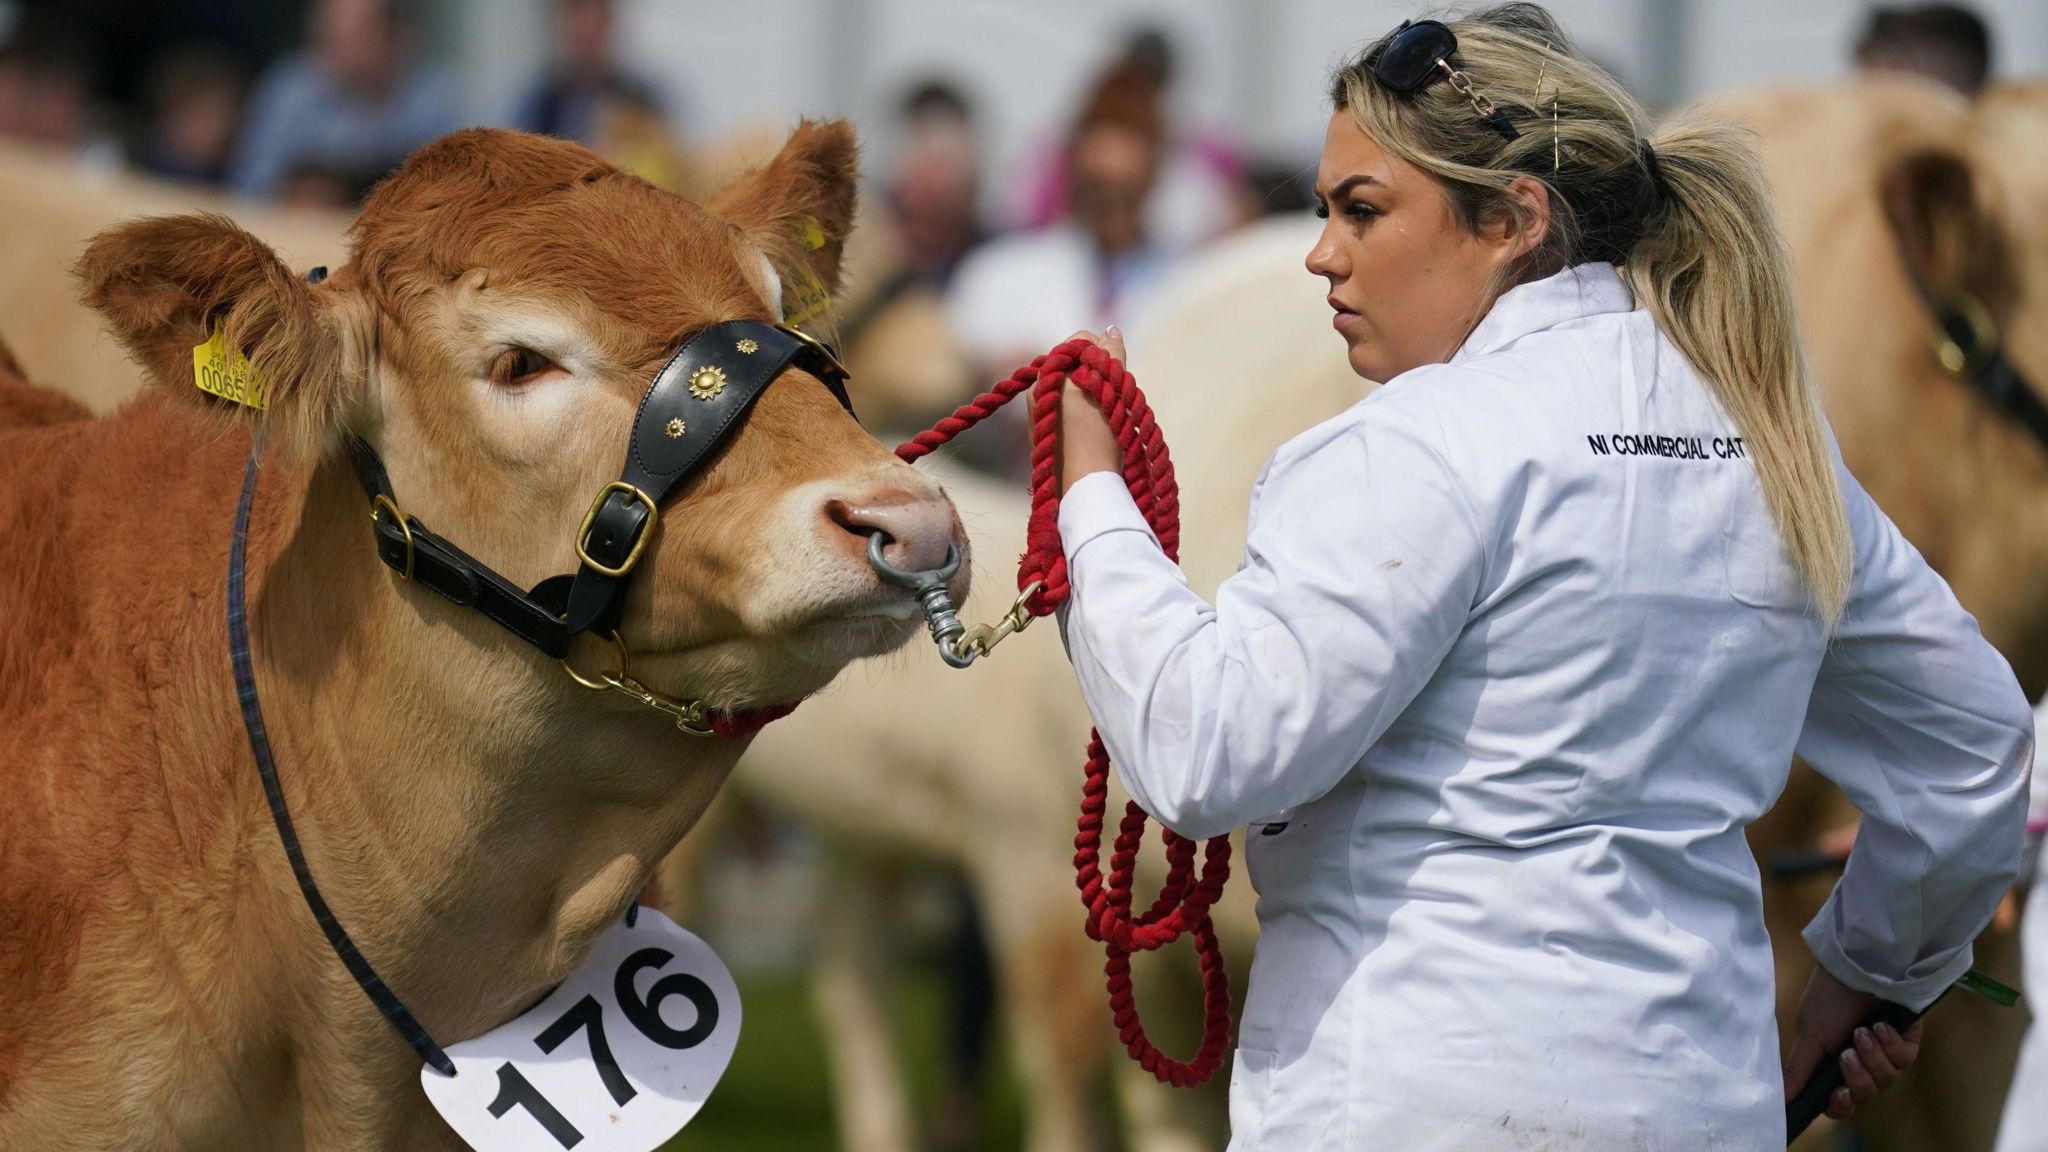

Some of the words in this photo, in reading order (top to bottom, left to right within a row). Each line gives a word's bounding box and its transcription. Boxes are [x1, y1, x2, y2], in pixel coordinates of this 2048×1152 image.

[1587, 434, 1610, 455] NI
[1611, 434, 1710, 460] COMMERCIAL
[486, 947, 719, 1151] 176
